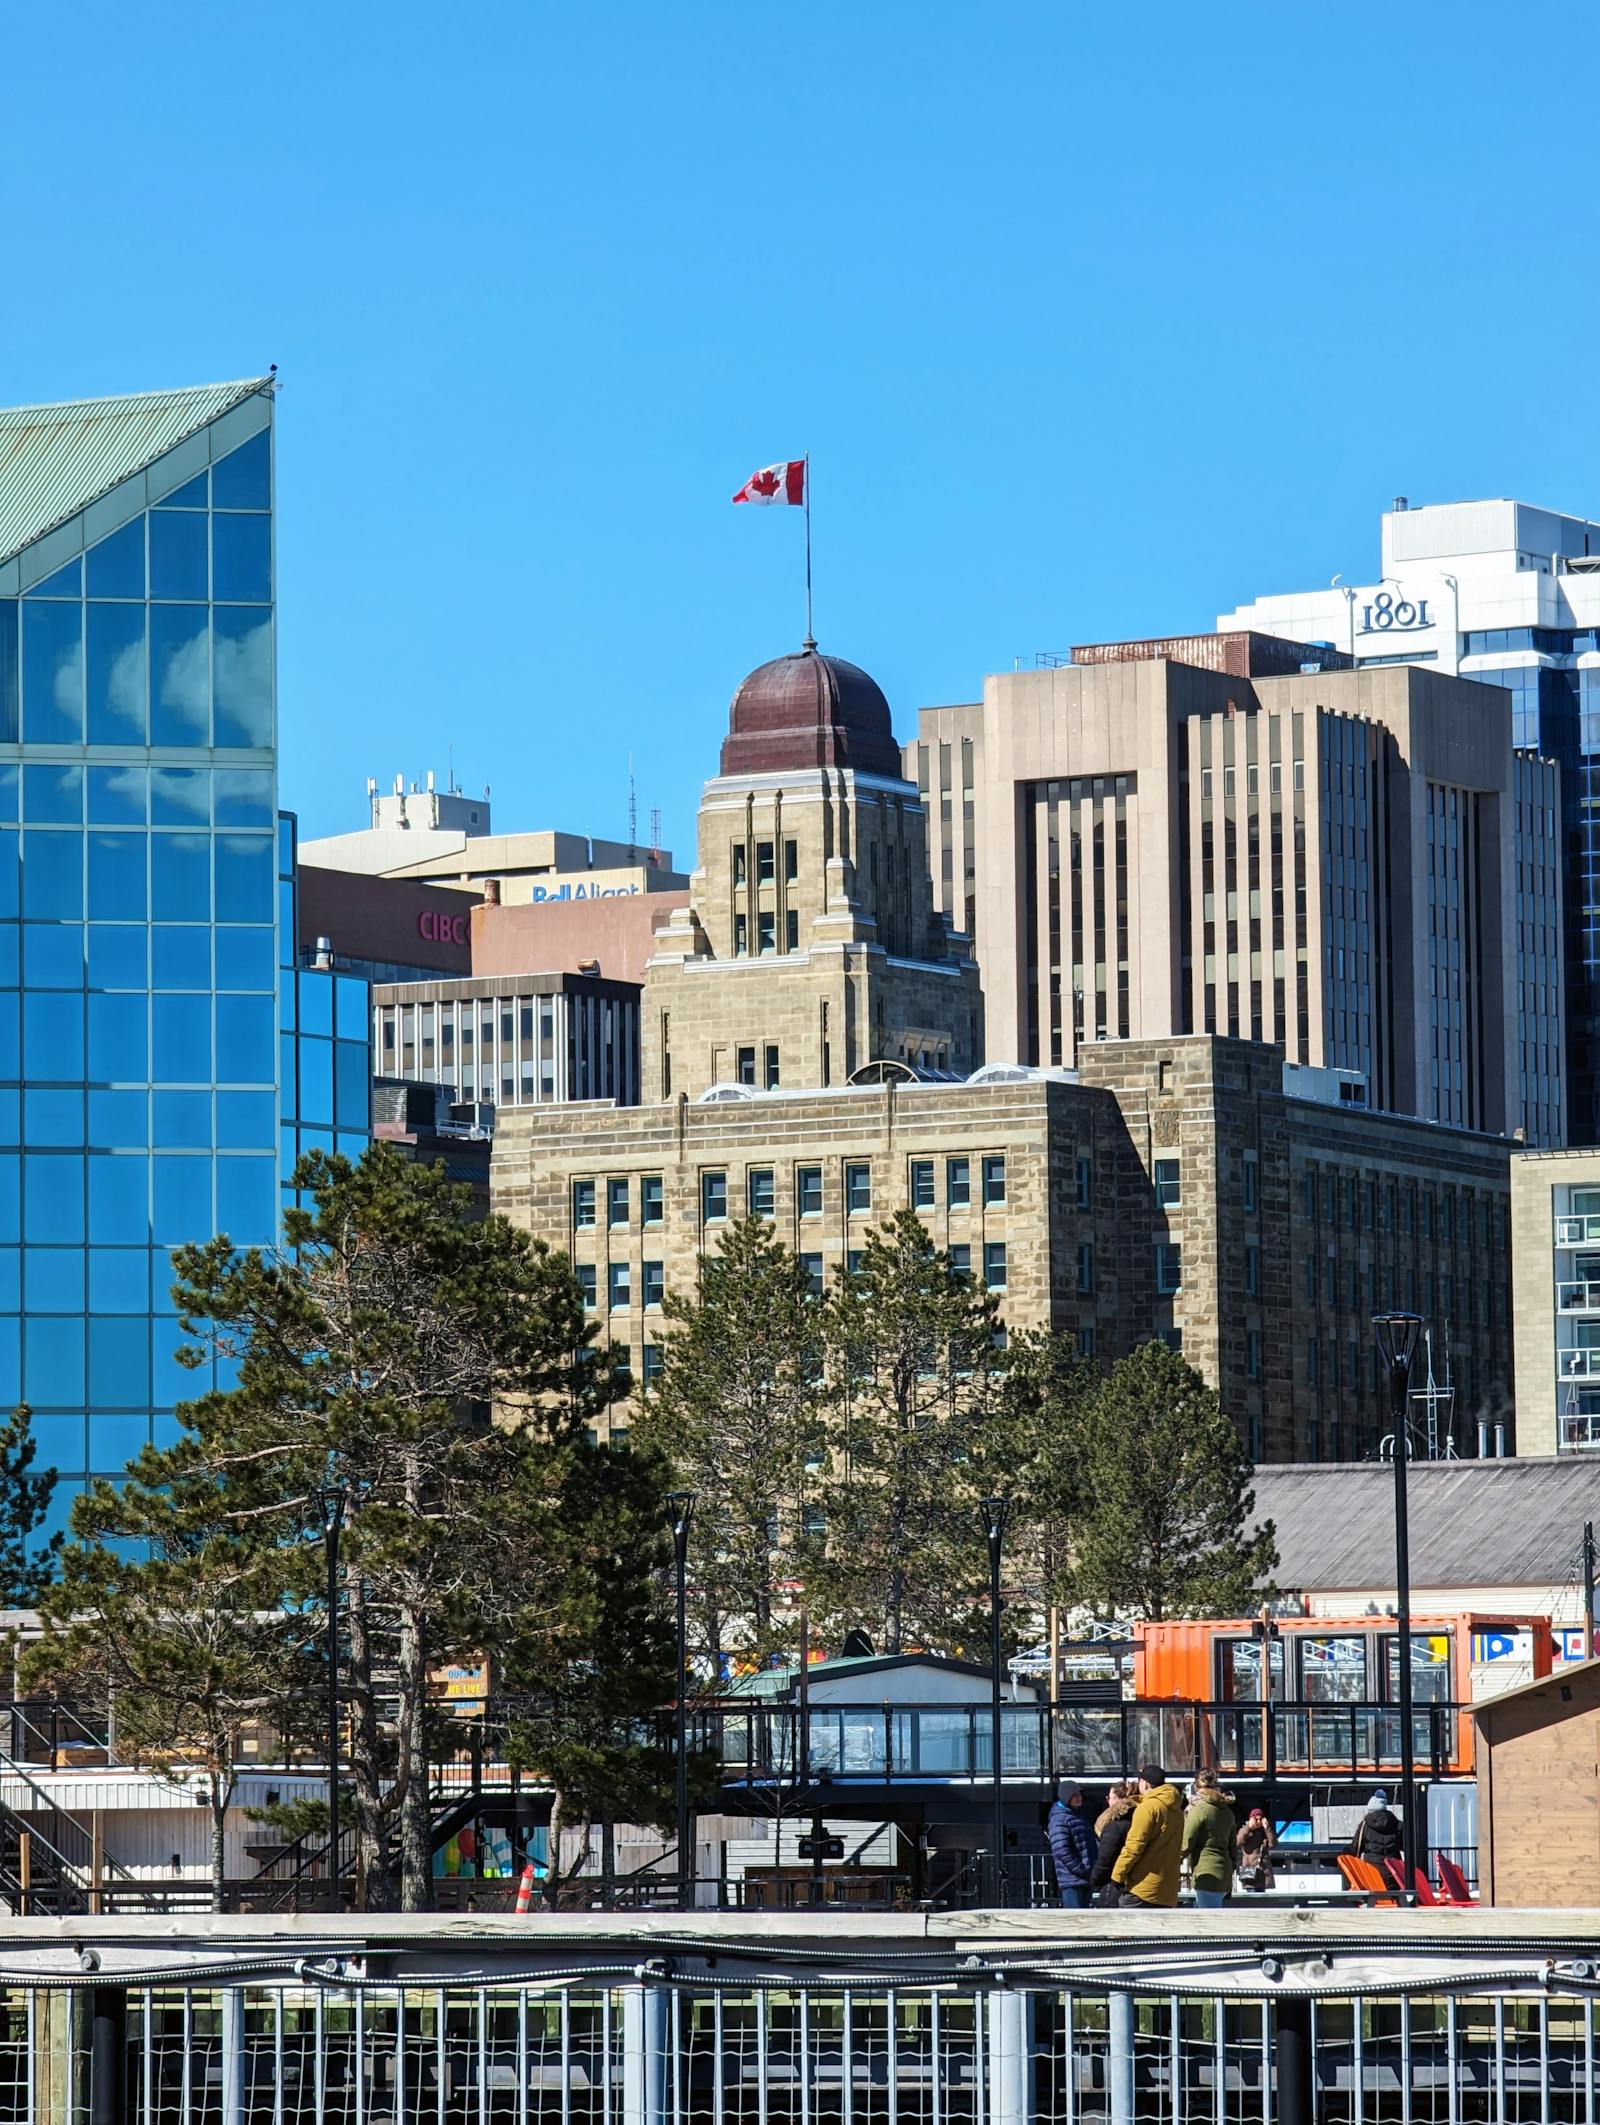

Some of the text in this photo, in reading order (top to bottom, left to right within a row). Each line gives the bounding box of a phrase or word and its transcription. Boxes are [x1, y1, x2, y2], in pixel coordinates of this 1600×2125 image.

[1362, 592, 1429, 630] 1801
[419, 911, 465, 944] CIBC
[448, 1684, 481, 1694] WE LIVE
